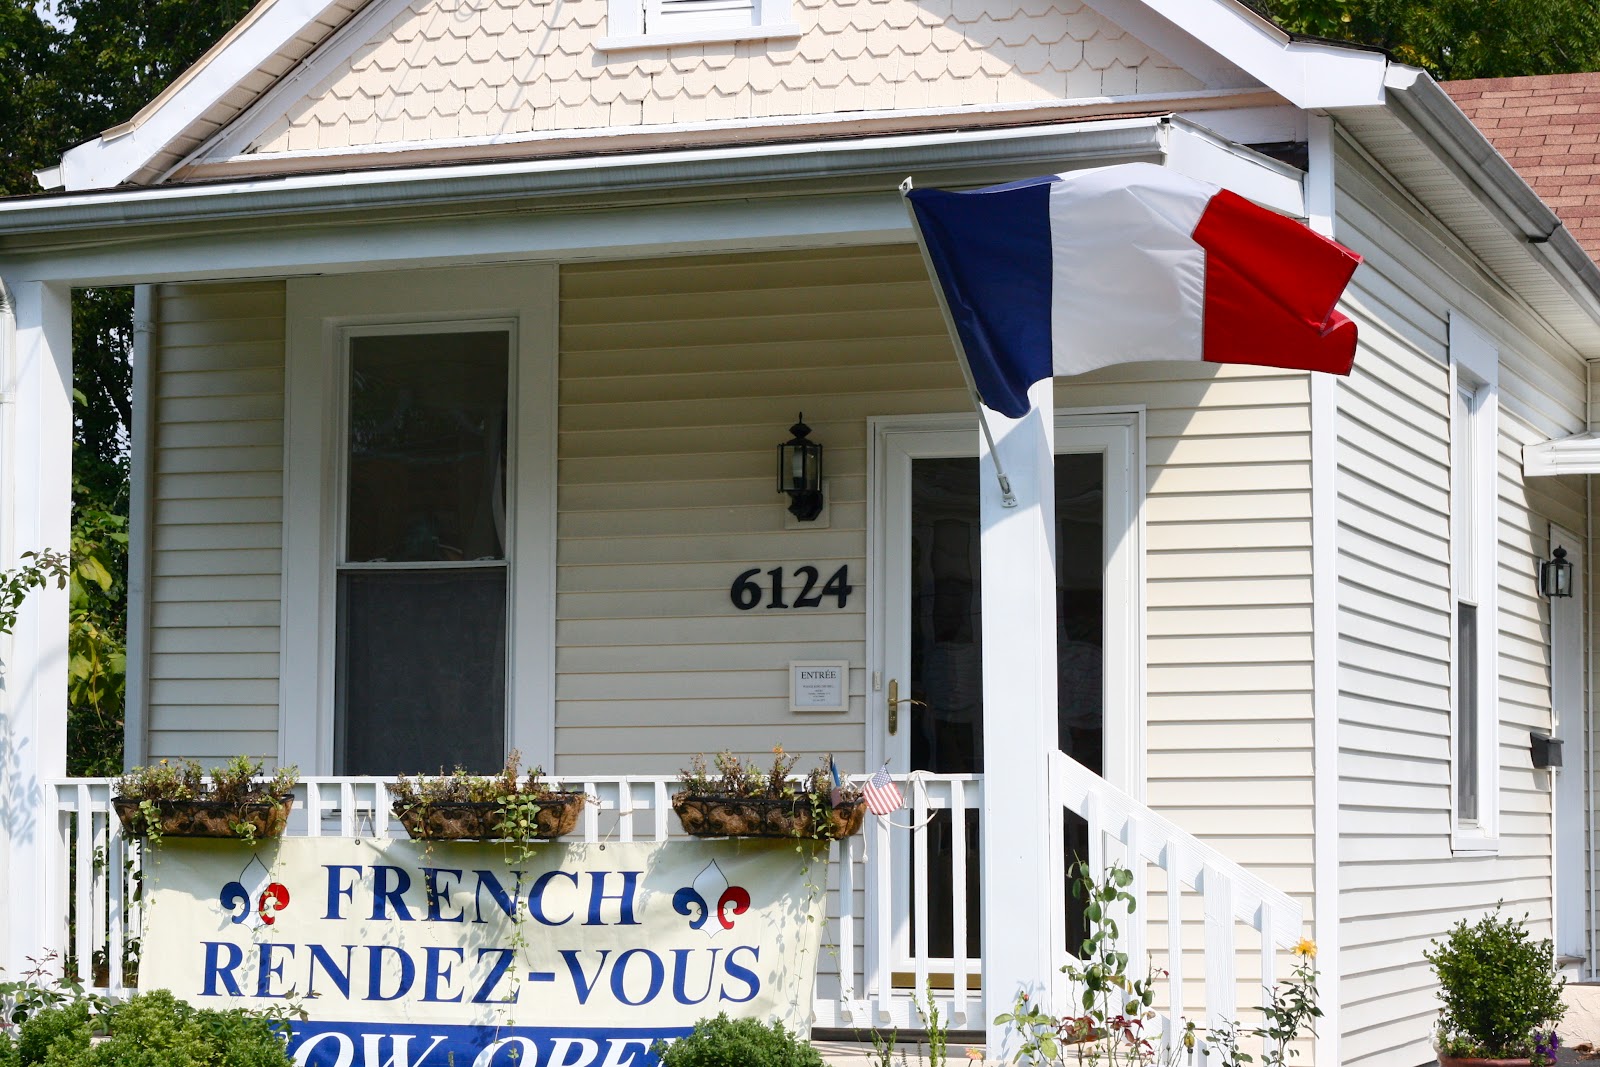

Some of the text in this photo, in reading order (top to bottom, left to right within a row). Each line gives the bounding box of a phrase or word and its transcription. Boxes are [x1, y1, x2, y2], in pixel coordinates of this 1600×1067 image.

[730, 564, 853, 611] 6124
[801, 669, 837, 680] ENTRÉE
[320, 864, 645, 927] FRENCH
[197, 941, 762, 1007] RENDEZ-VOUS
[274, 1031, 680, 1067] OW OPE
